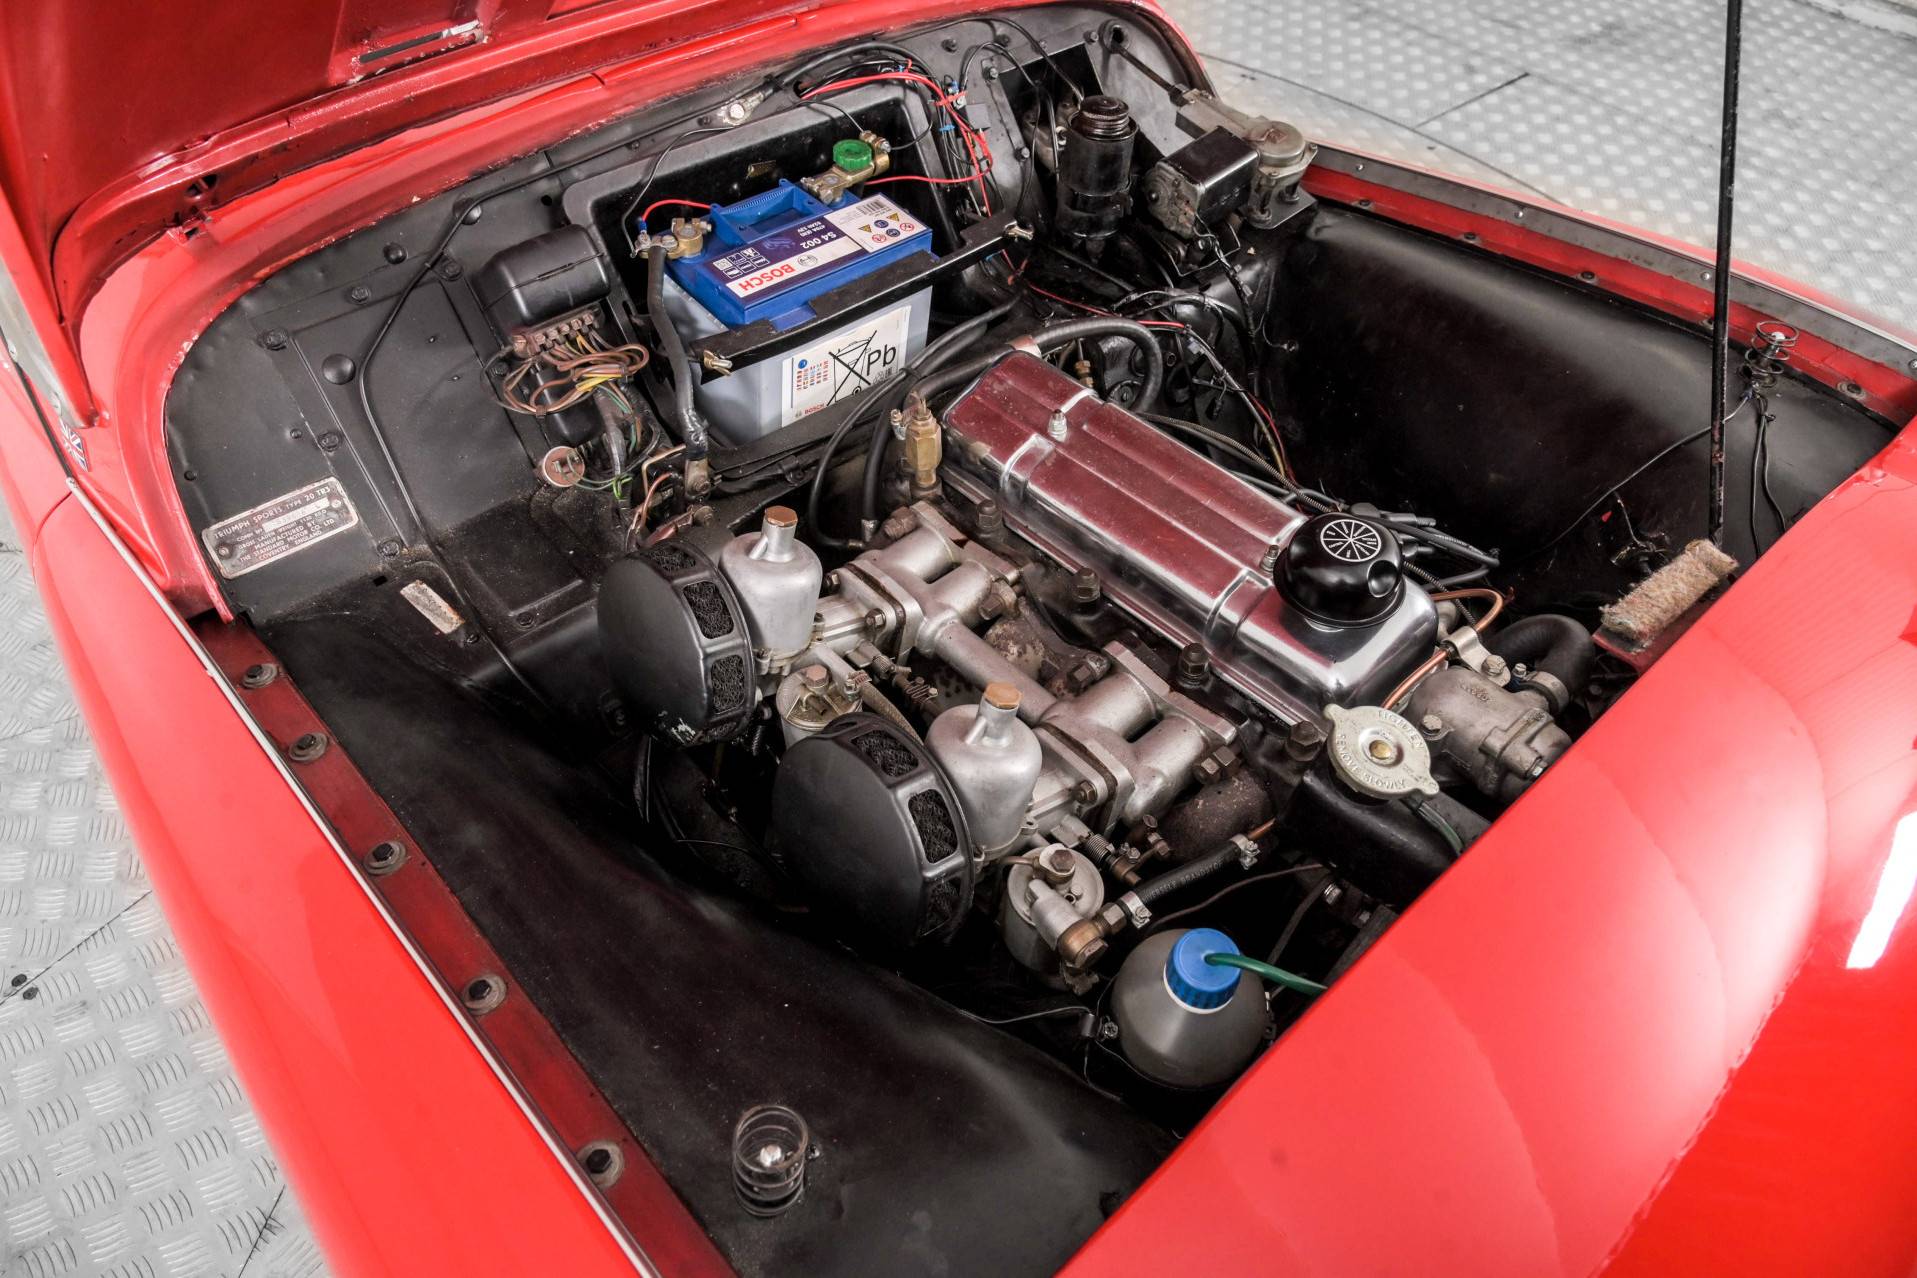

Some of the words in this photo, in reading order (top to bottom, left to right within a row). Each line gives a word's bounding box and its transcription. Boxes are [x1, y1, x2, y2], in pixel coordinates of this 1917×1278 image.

[800, 238, 822, 249] 002
[821, 231, 837, 241] S4
[738, 263, 796, 292] BOSCH
[866, 343, 897, 377] Pb
[214, 520, 250, 539] TRIUMPH
[253, 506, 282, 523] SPORTS
[304, 492, 315, 502] 20
[240, 554, 251, 562] THE
[253, 540, 285, 557] STANDARD
[286, 530, 309, 542] MOTOR
[254, 525, 304, 550] MANUFACTURED
[307, 520, 316, 528] BY
[258, 544, 290, 560] COVENTRY
[294, 530, 322, 545] ENGLAND
